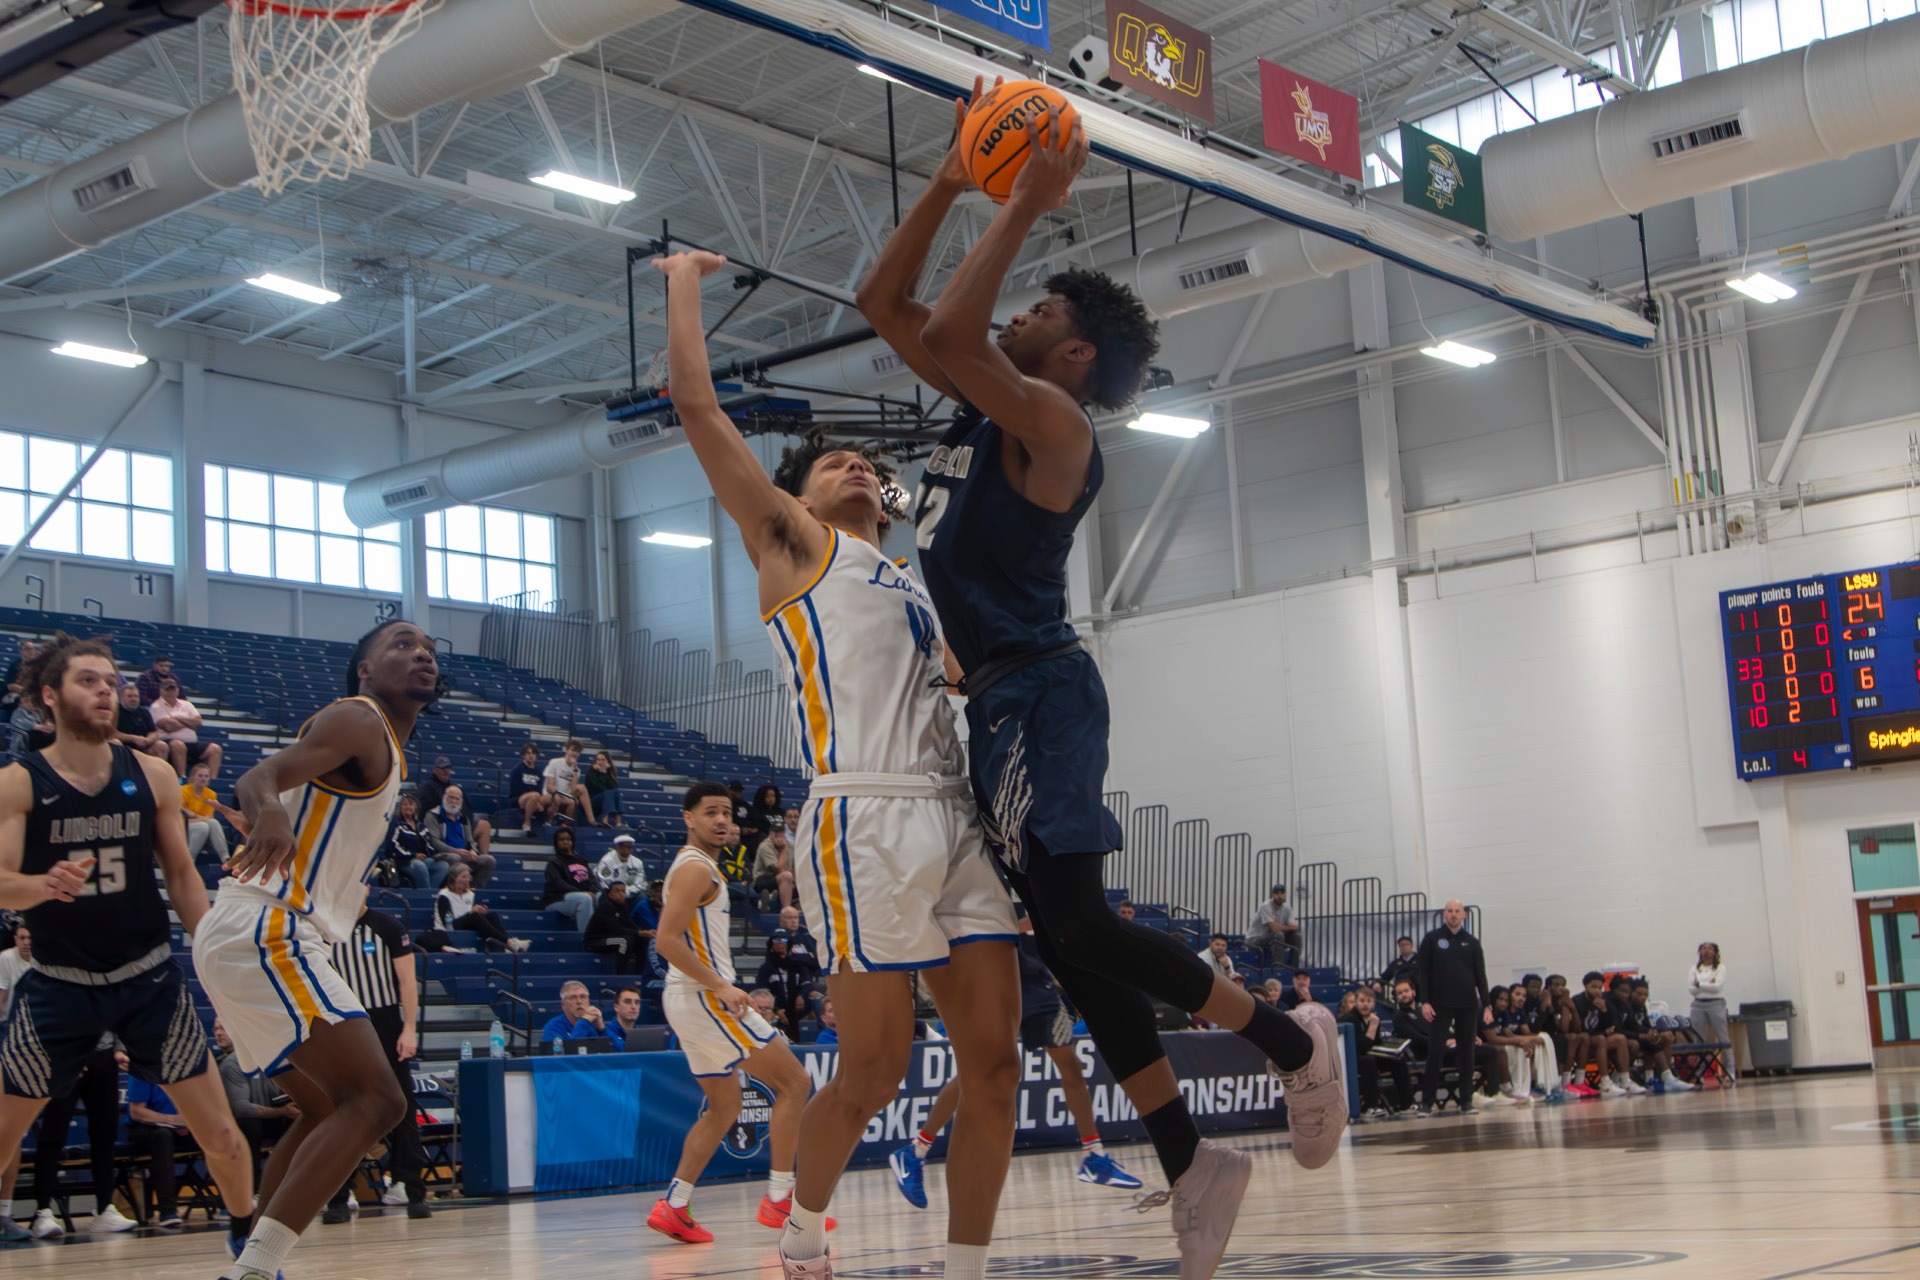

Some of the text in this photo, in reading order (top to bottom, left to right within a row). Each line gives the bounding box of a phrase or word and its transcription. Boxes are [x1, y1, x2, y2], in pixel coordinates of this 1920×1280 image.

[979, 94, 1050, 157] Wilson
[1296, 117, 1329, 142] UMSL
[134, 573, 153, 596] 11
[1728, 581, 1824, 609] player points fouls
[1845, 572, 1877, 591] LSSU
[376, 601, 396, 618] 12
[1740, 600, 1826, 631] 11 0 1
[1848, 591, 1883, 624] 24
[1756, 623, 1829, 653] 1 0 0
[1738, 649, 1831, 681] 33 0 1
[1848, 646, 1875, 662] fouls
[1752, 671, 1834, 704] 0 0 0
[1860, 666, 1875, 690] 6
[1750, 698, 1837, 728] 10 2 1
[1856, 695, 1878, 709] won
[1743, 748, 1807, 773] t.o.l. 4
[49, 810, 141, 844] LINCOLN
[67, 845, 126, 896] 25
